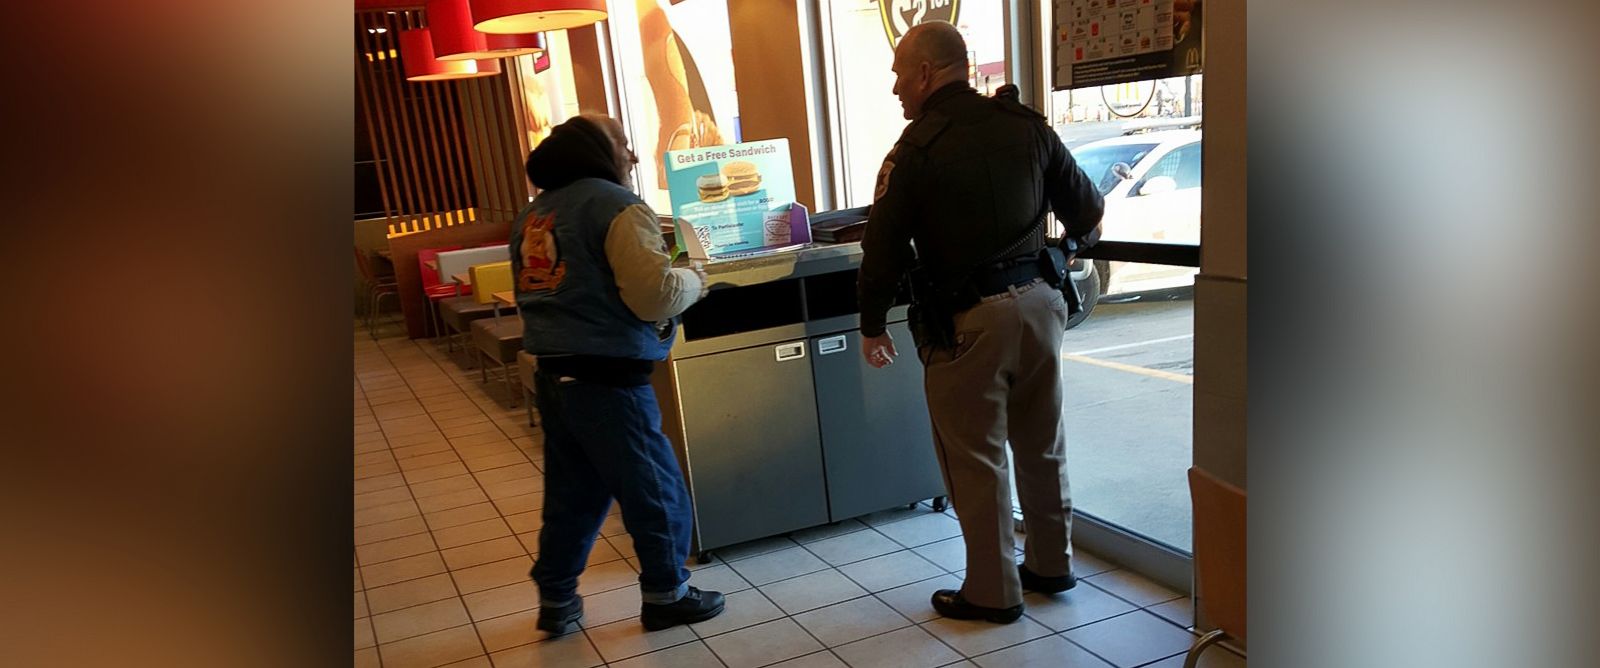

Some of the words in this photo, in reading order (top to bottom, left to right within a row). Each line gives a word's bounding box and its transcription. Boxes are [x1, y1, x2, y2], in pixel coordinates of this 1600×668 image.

[677, 154, 695, 164] Get
[697, 154, 704, 162] a
[705, 151, 727, 161] Free
[728, 145, 776, 158] Sandwich
